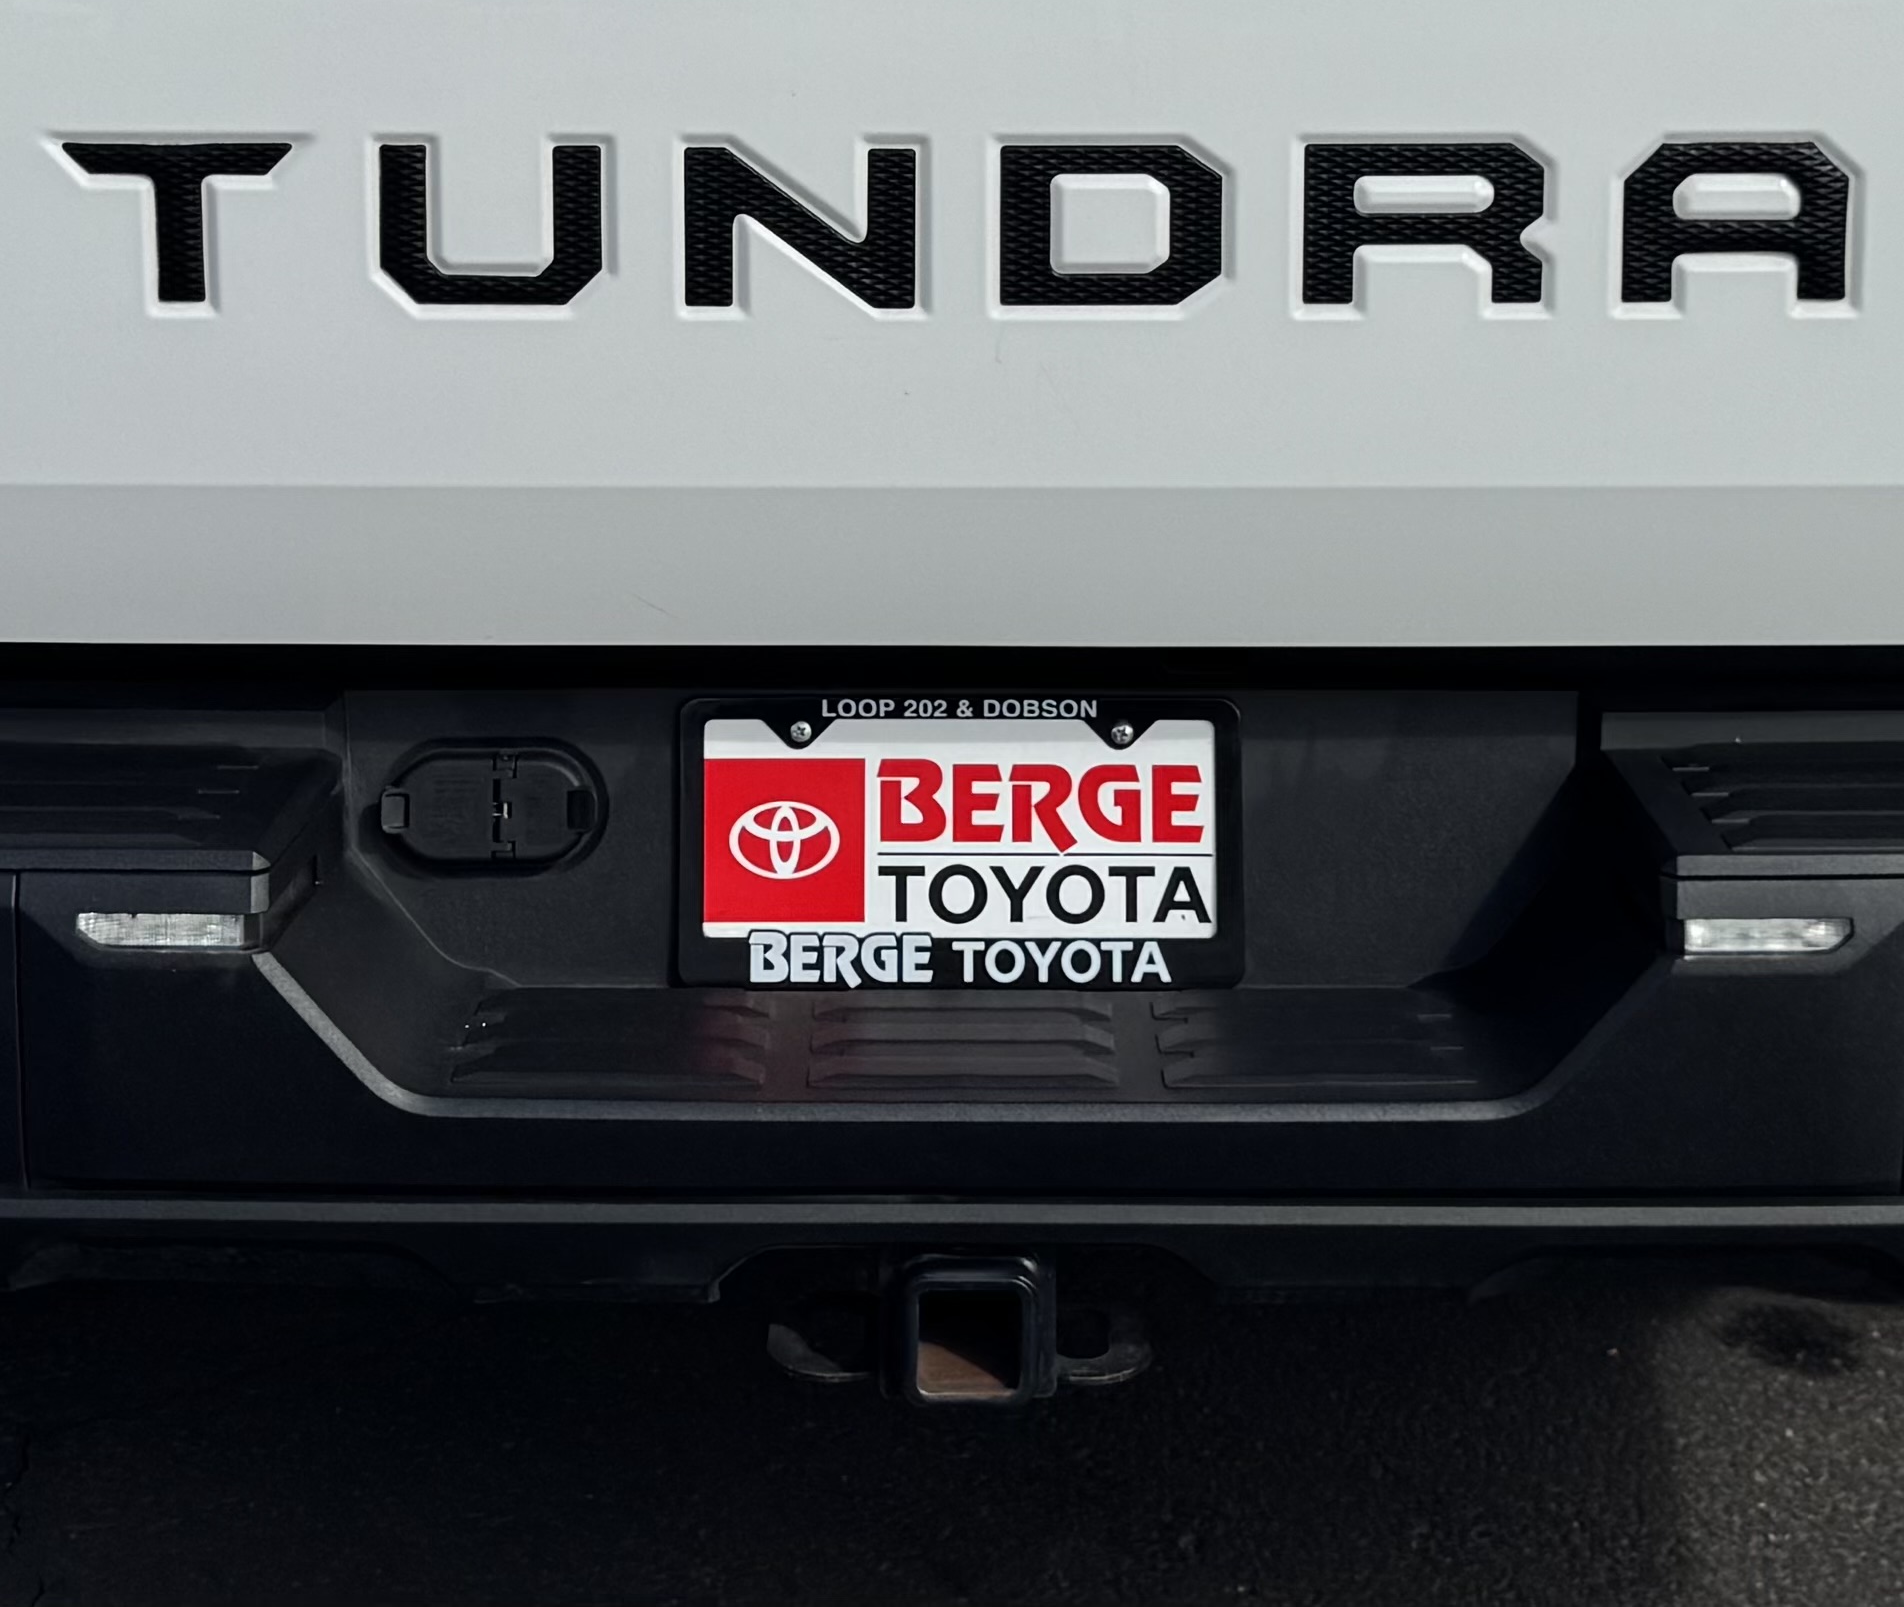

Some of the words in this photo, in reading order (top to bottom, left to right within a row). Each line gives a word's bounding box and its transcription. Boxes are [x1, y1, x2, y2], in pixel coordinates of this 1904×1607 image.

[56, 138, 1854, 310] TUNDRA
[820, 698, 896, 719] LOOP
[903, 698, 950, 719] 202
[956, 698, 973, 719] &
[982, 698, 1099, 719] DOBSON
[876, 757, 1205, 854] BERGE
[877, 864, 1212, 924] TOYOTA
[747, 931, 934, 989] BERGE
[951, 939, 1172, 984] TOYOTA
